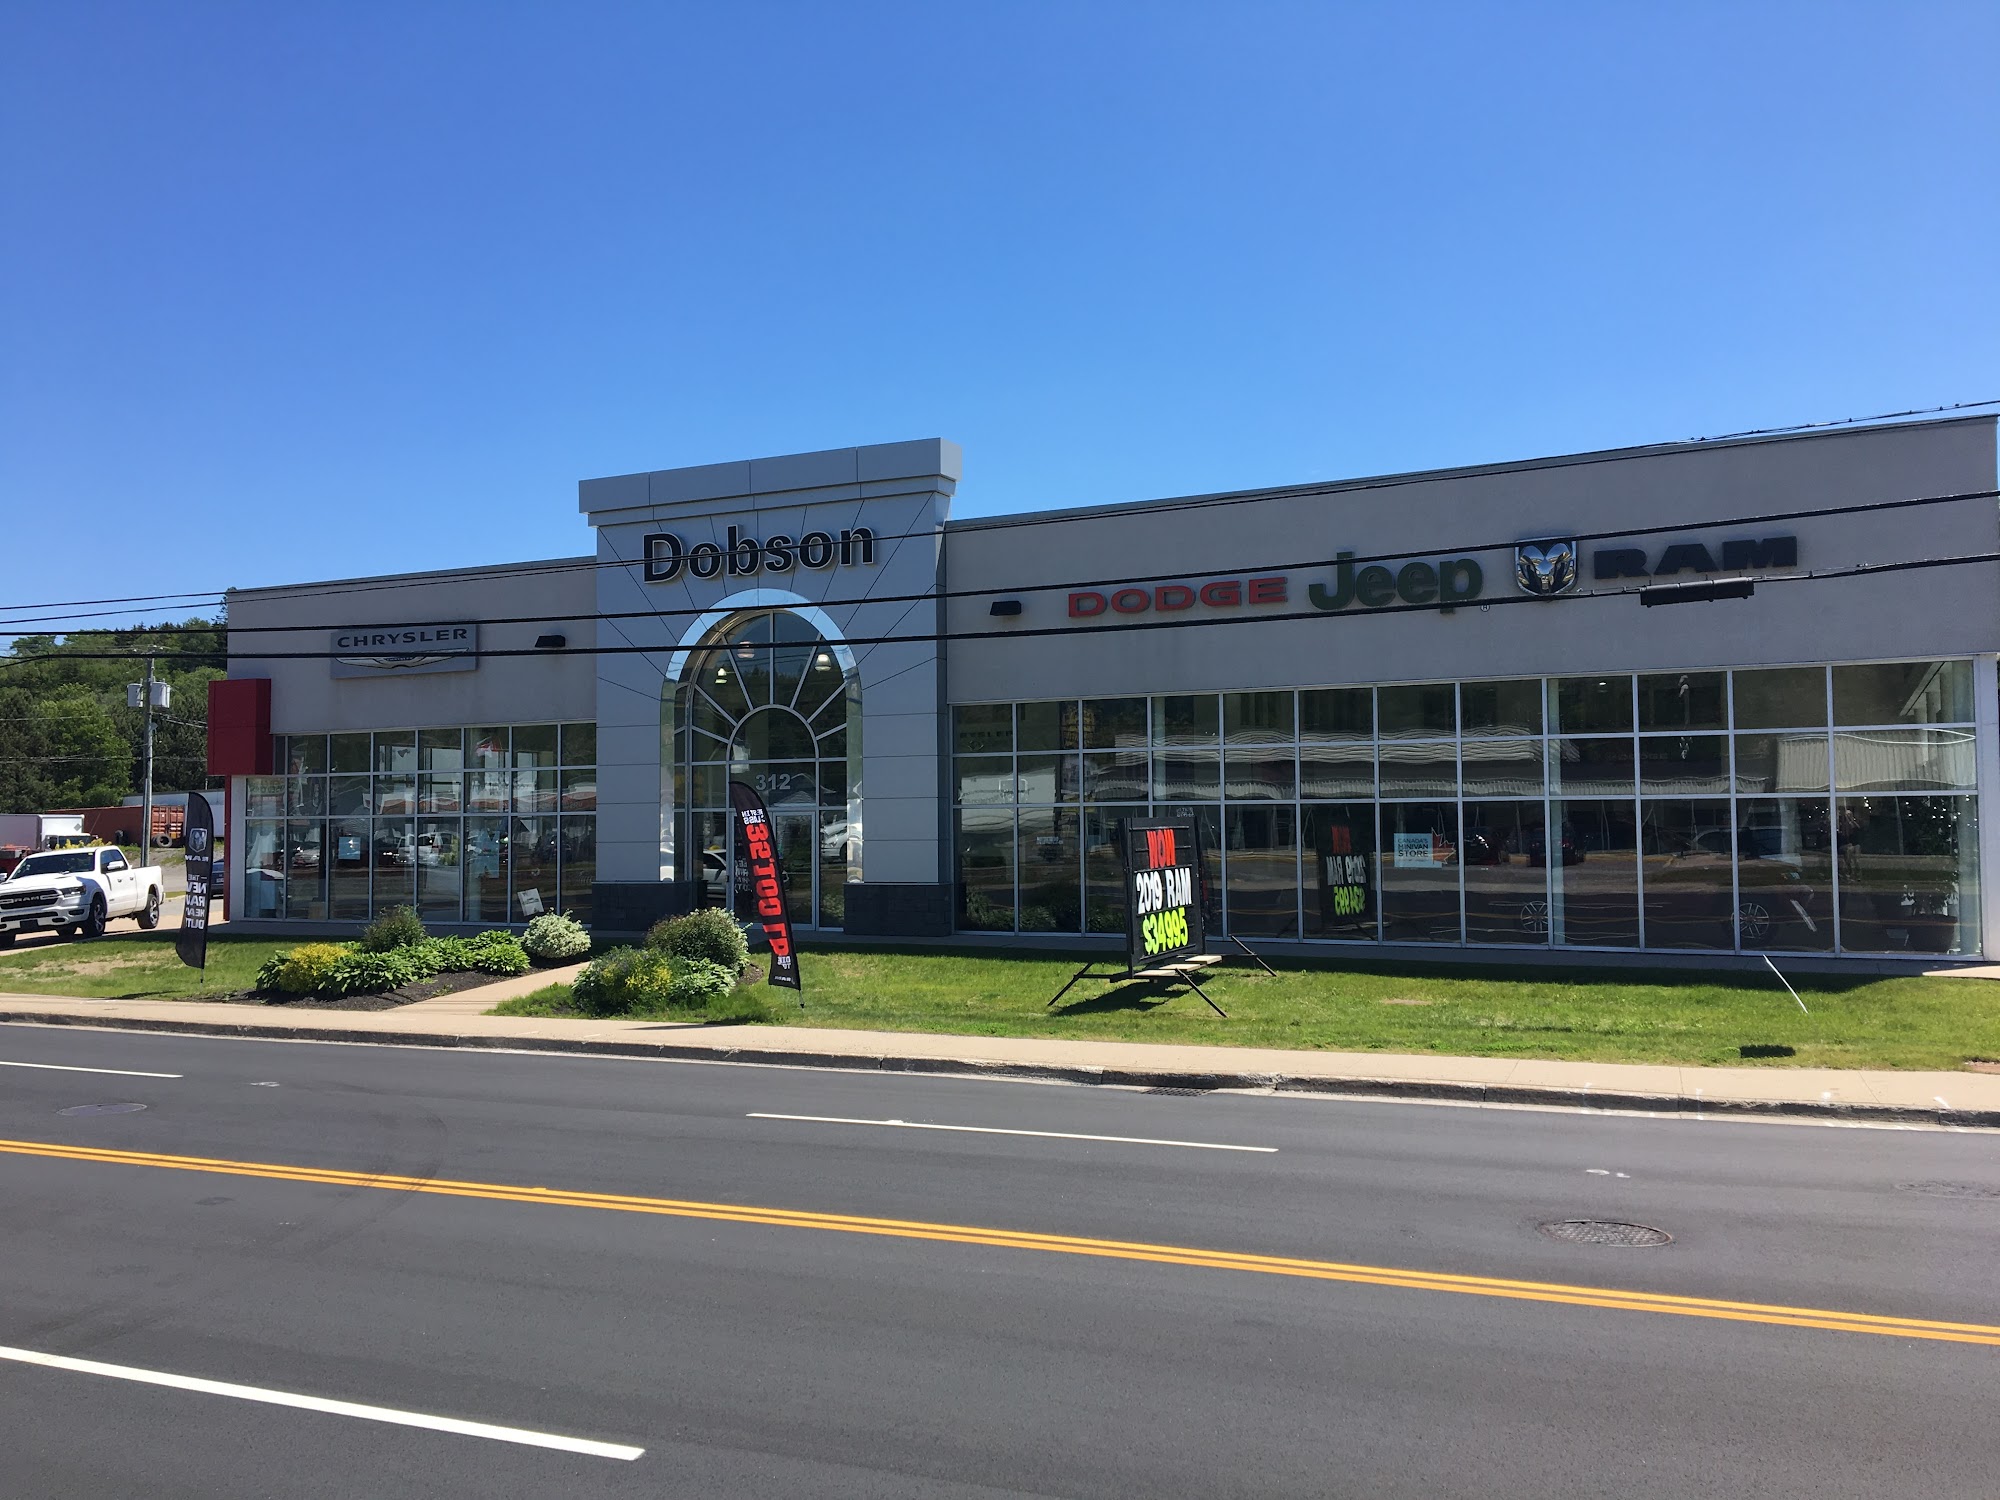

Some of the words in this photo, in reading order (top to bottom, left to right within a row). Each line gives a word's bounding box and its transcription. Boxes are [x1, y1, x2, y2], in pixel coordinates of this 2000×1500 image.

[642, 524, 874, 583] Dobson
[1593, 535, 1798, 580] RAM
[1067, 576, 1288, 618] DODGE
[1308, 551, 1484, 614] Jeep
[336, 628, 468, 648] CHRYSLER
[755, 773, 791, 790] 312
[1398, 850, 1429, 858] STORE
[1136, 870, 1163, 914] 2019
[1165, 868, 1192, 908] RAM
[1142, 907, 1188, 955] $34995
